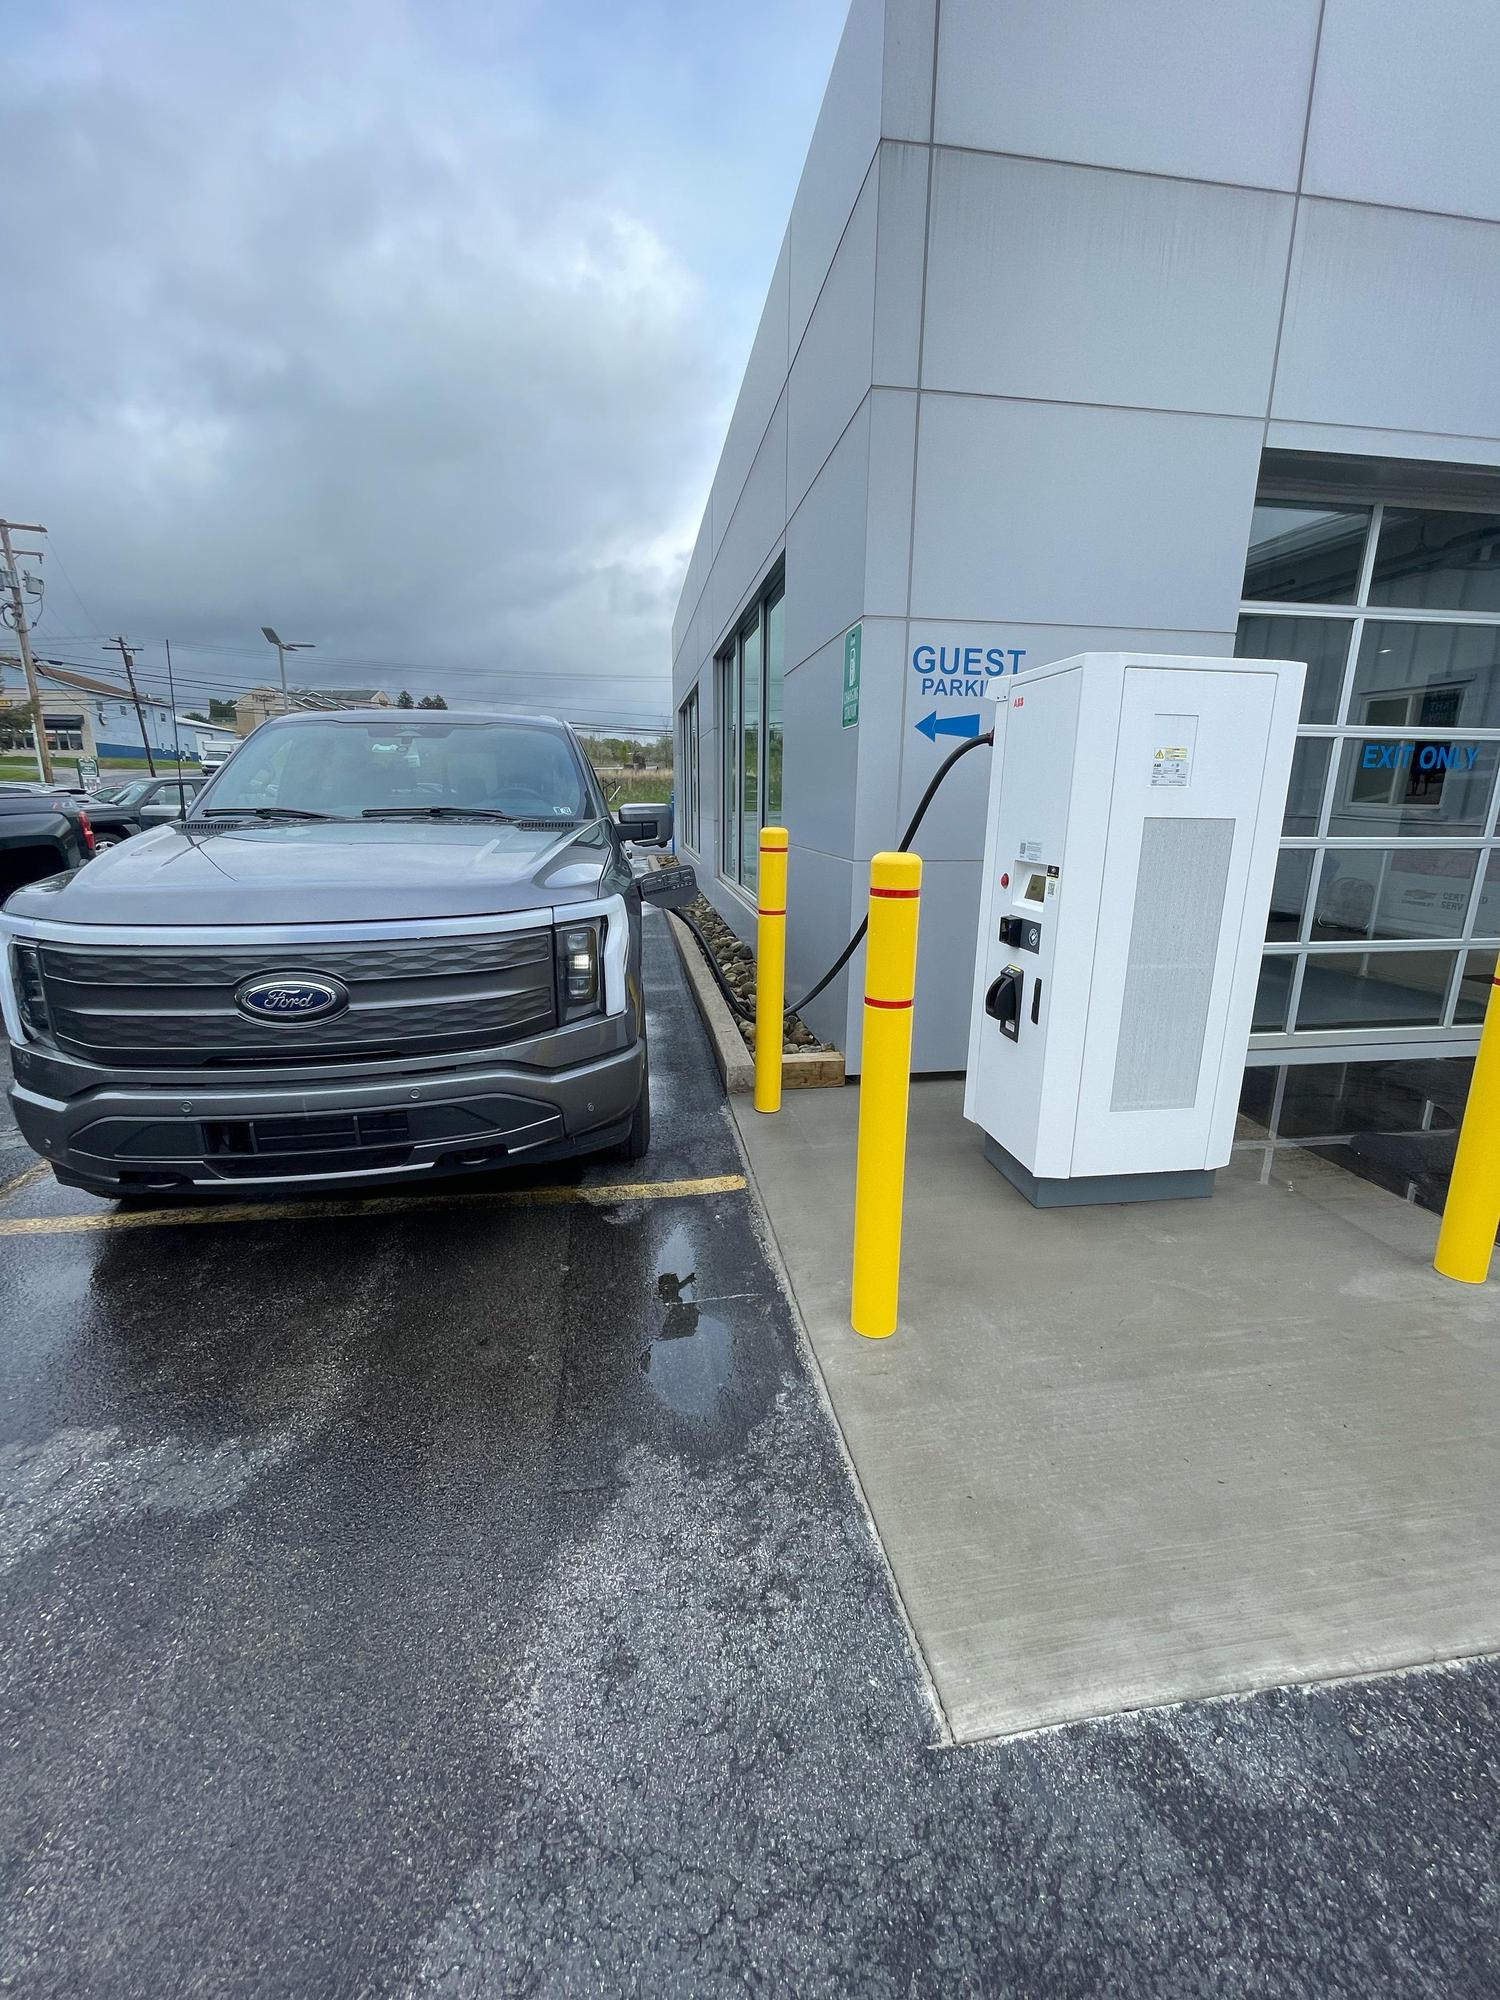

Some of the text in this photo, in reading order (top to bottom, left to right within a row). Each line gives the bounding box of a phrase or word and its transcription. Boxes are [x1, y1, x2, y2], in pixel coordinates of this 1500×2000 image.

[912, 645, 1027, 676] GUEST
[921, 678, 989, 697] PARKI
[1362, 743, 1481, 770] EXIT ONLY
[263, 989, 314, 1009] Ford
